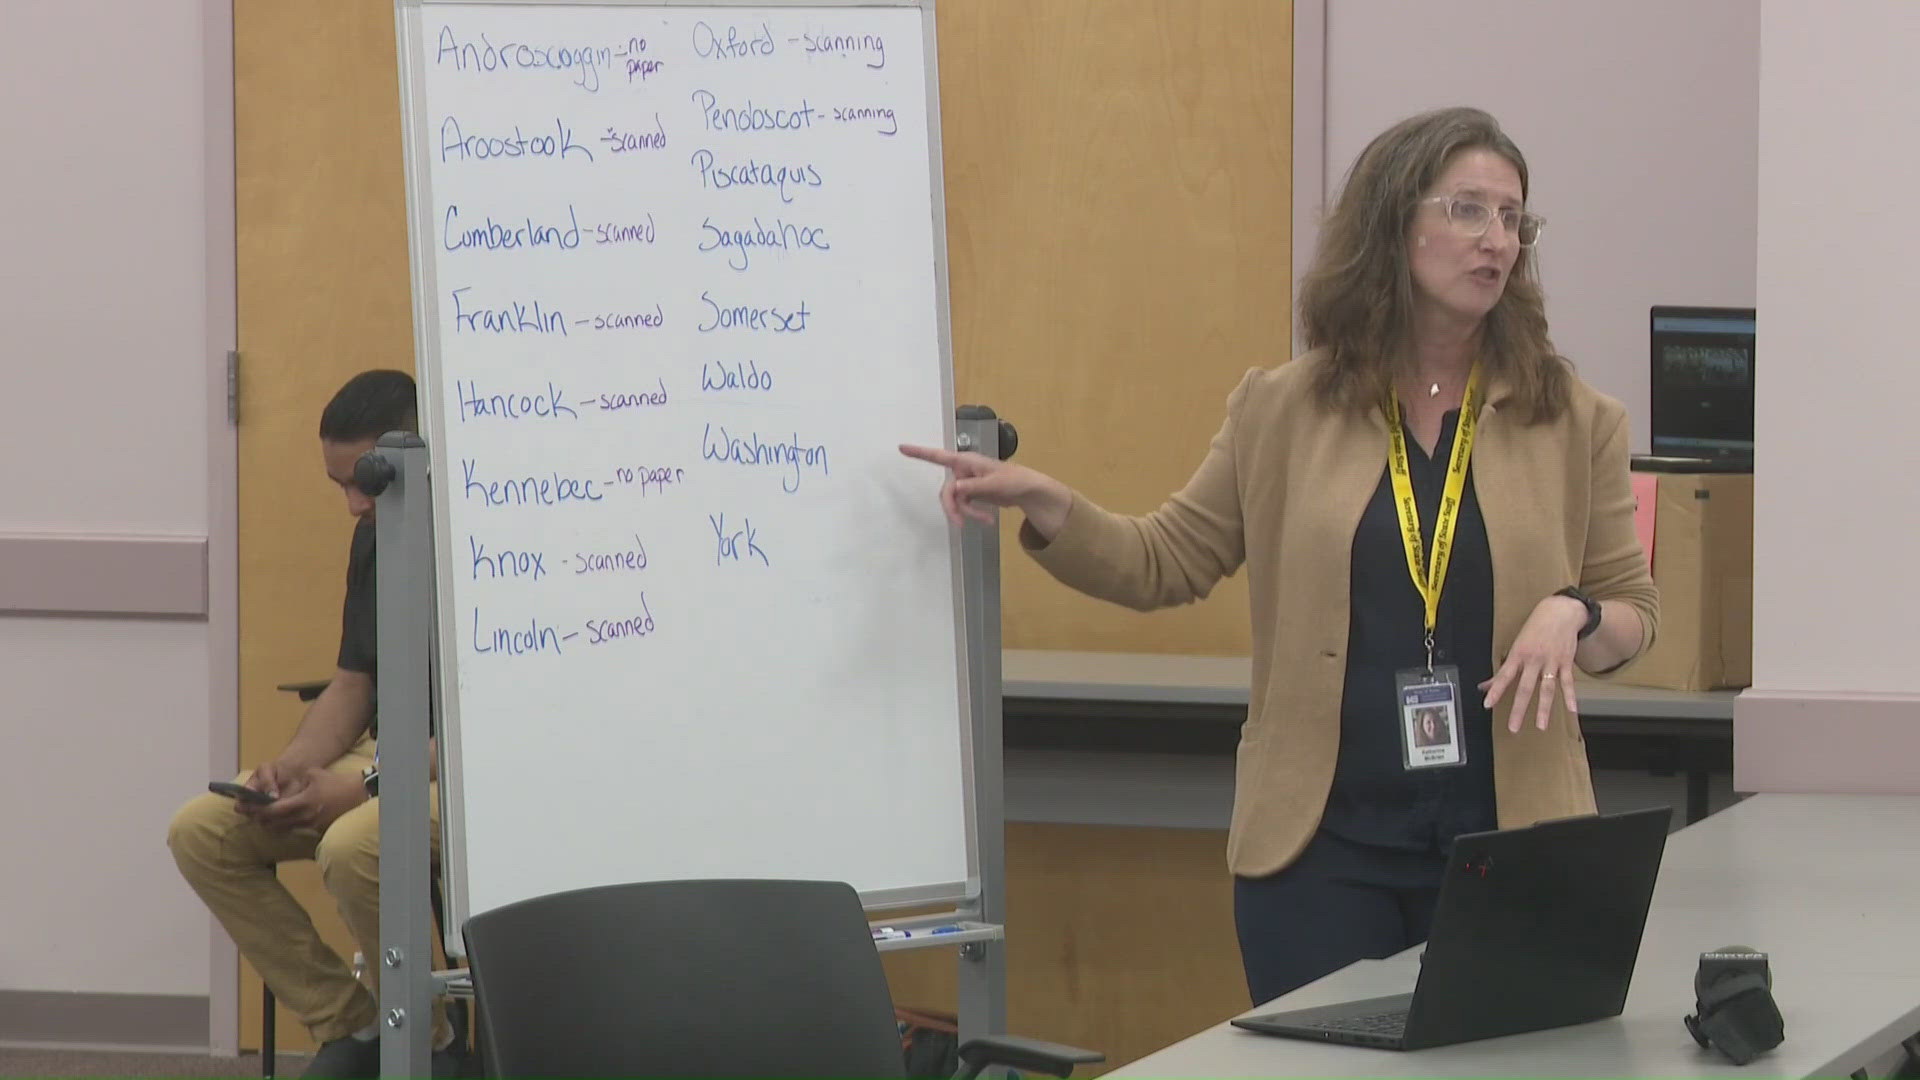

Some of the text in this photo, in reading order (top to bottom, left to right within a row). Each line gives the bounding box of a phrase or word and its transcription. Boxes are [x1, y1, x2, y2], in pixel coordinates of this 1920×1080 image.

[437, 25, 611, 92] Androscoggin
[628, 37, 647, 54] no
[692, 21, 775, 59] Oxford
[803, 33, 885, 68] scanning
[626, 58, 664, 84] paper
[691, 89, 815, 131] Penobscot
[833, 106, 898, 135] scanning
[441, 116, 594, 163] Aroostook
[690, 149, 822, 203] Piscataquis
[444, 204, 580, 251] Cumberland
[698, 216, 831, 271] Sagadahoc
[452, 286, 568, 337] Franklin
[594, 303, 664, 330] scanned
[698, 290, 811, 332] Somerset
[702, 360, 773, 391] Waldo
[457, 380, 578, 423] Hancock
[599, 377, 668, 410] scanned
[702, 422, 829, 494] Washington
[462, 458, 603, 508] Kennebec
[616, 466, 634, 484] no
[637, 465, 685, 498] paper
[469, 535, 547, 581] Knox
[575, 533, 648, 575] scanned
[709, 511, 769, 568] York
[473, 606, 562, 655] Lincoln
[586, 590, 655, 644] scanned
